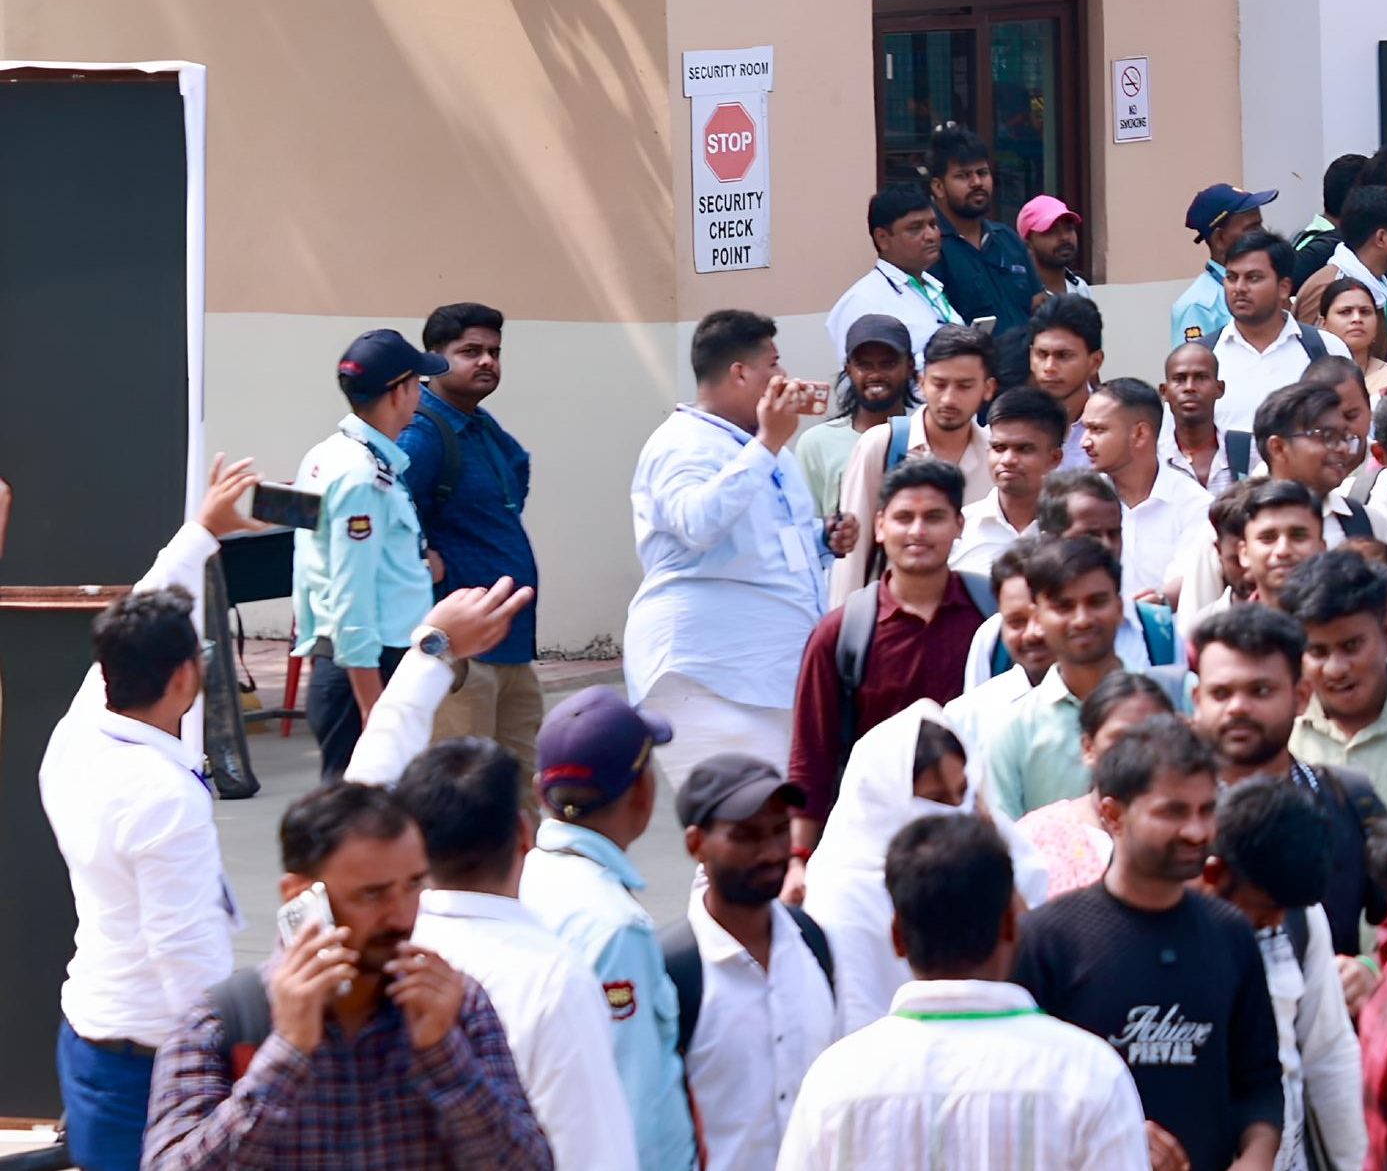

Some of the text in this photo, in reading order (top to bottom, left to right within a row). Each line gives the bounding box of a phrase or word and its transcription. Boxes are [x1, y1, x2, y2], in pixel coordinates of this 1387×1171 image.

[688, 61, 770, 80] SECURITY ROOM
[707, 131, 752, 154] STOP
[698, 191, 764, 214] SECURITY
[709, 218, 754, 240] CHECK
[712, 245, 751, 267] POINT
